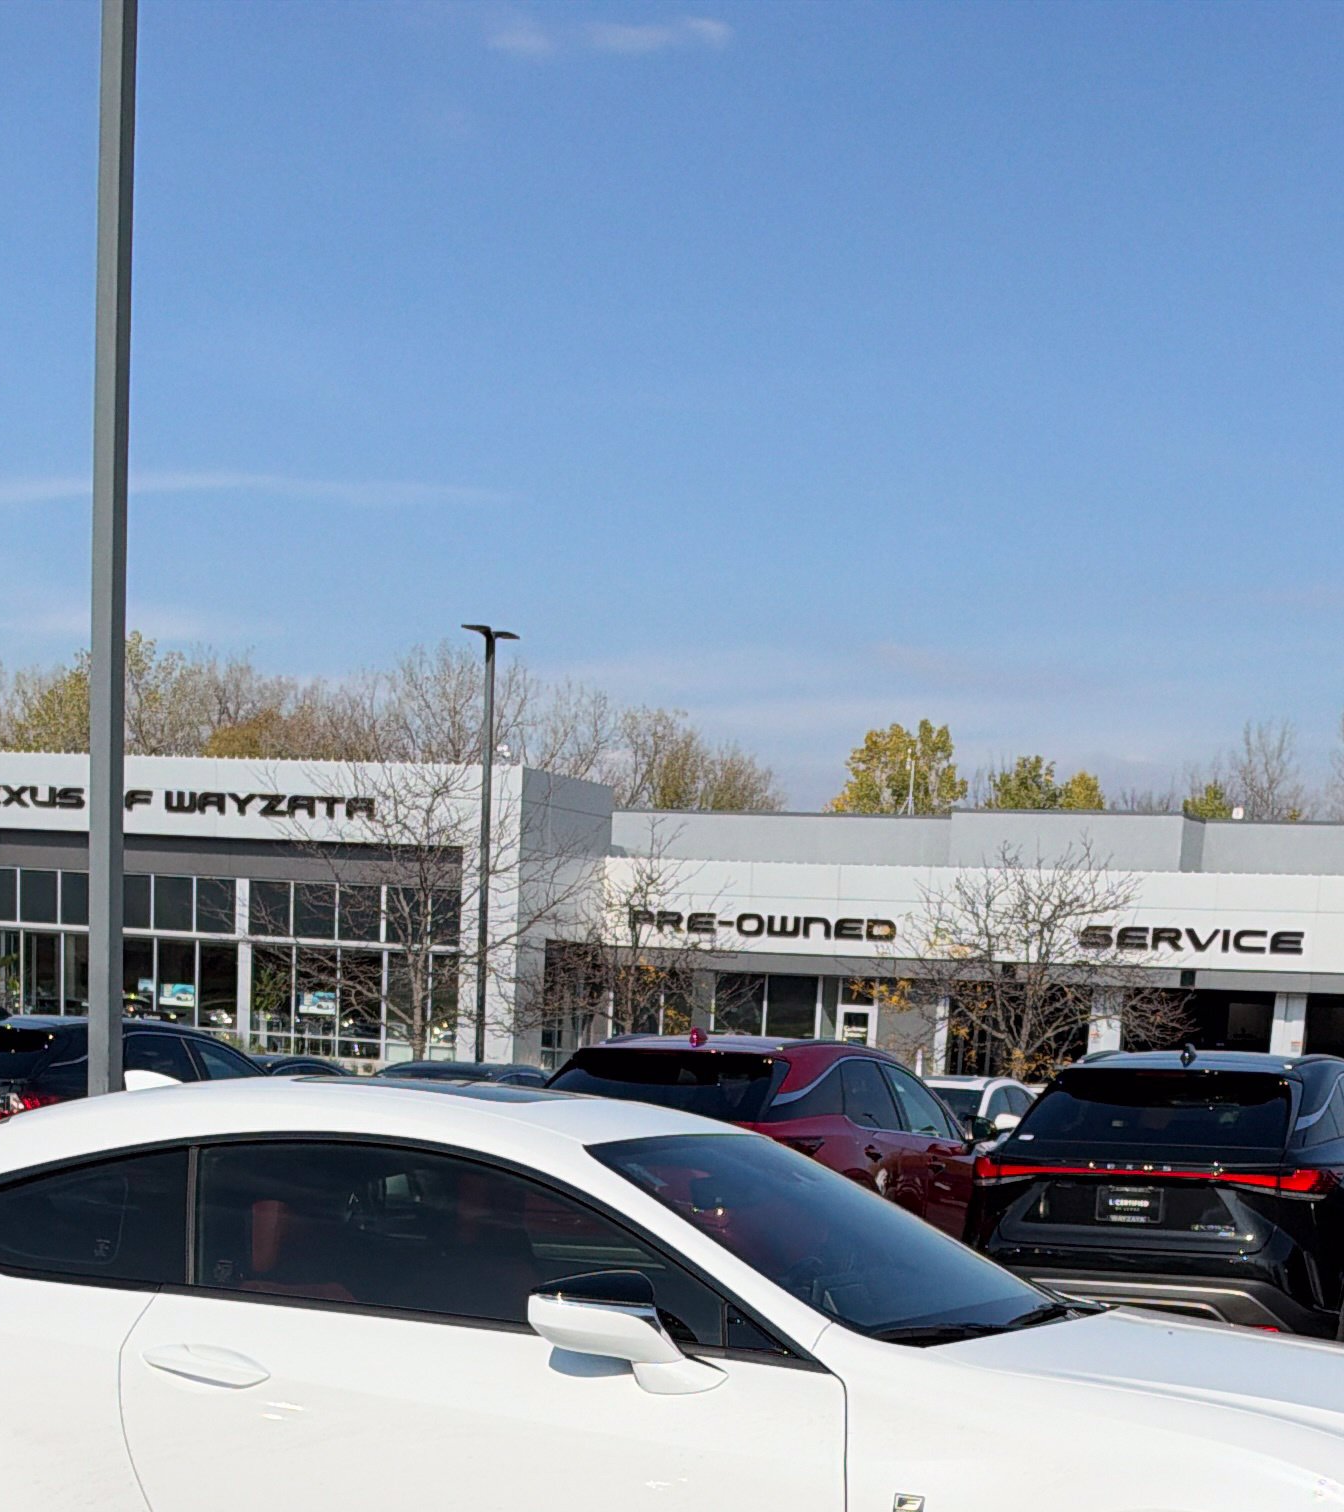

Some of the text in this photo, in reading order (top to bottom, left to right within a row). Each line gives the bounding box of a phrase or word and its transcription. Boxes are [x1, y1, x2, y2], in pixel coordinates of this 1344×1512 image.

[124, 789, 154, 813] F
[164, 790, 377, 822] WAYZATA
[630, 909, 897, 942] PRE-OWNED
[1079, 925, 1305, 956] SERVICE
